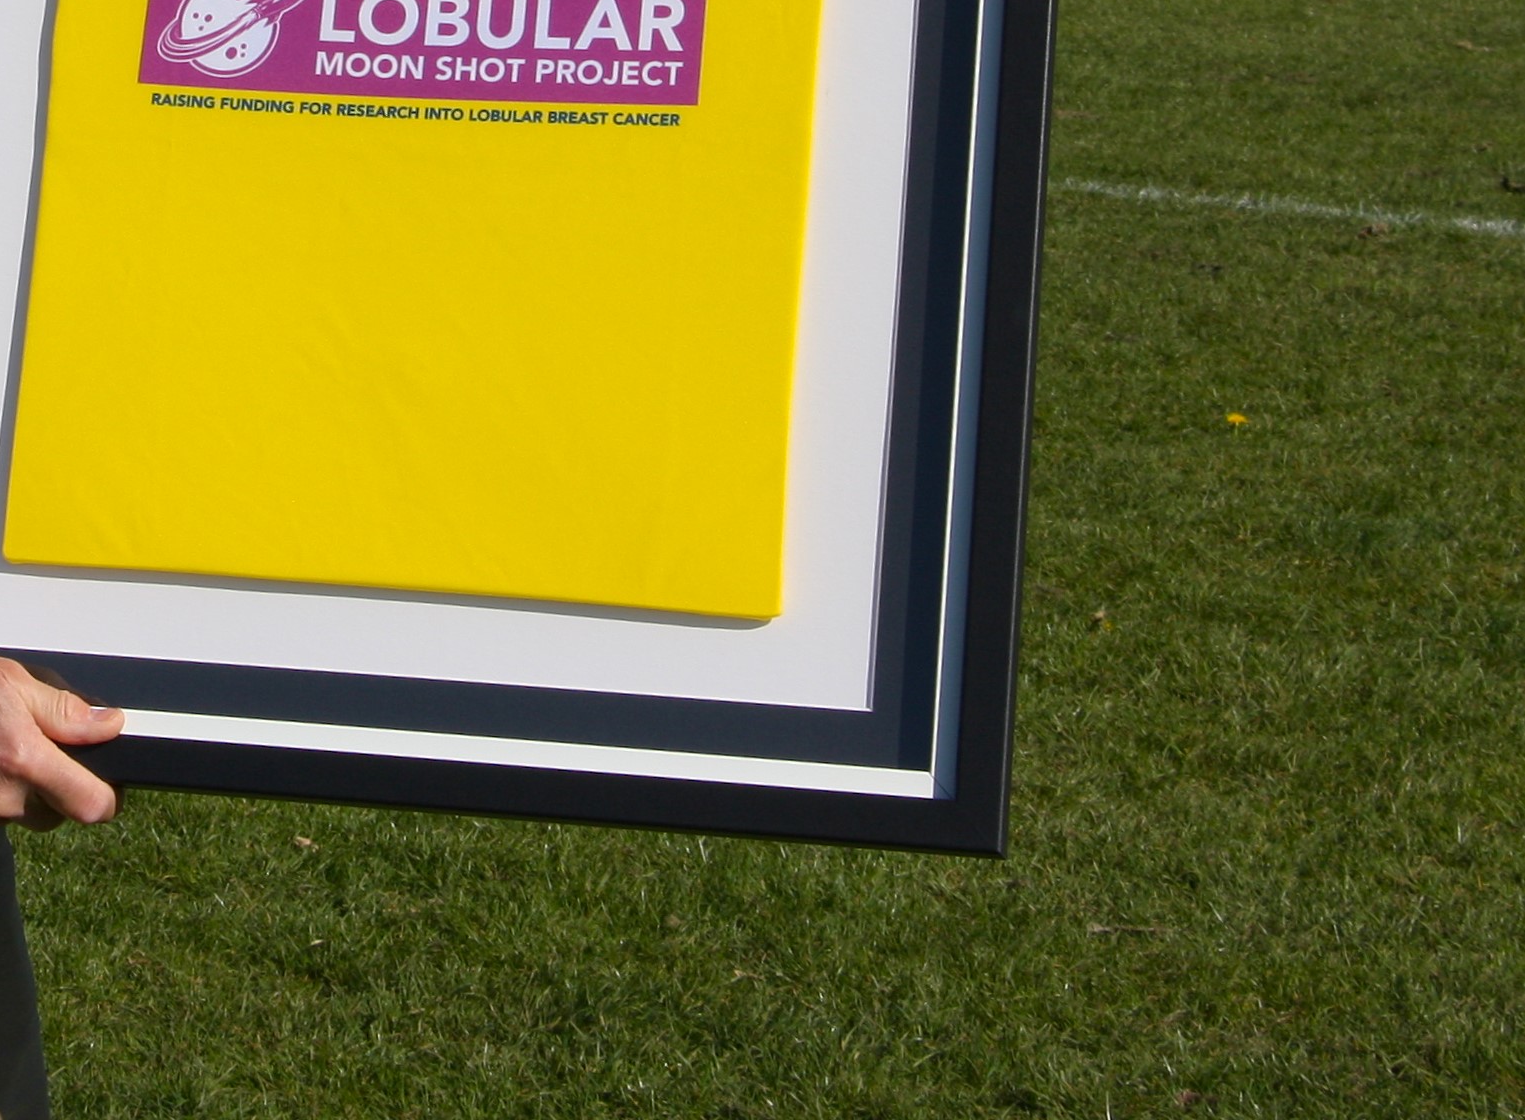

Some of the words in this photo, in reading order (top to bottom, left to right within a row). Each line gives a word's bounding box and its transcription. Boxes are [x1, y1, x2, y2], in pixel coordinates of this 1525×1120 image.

[315, 51, 425, 80] MOON
[435, 55, 526, 83] SHOT
[535, 59, 684, 86] PROJECT
[151, 93, 216, 109] RAISING
[220, 97, 295, 113] FUNDING
[299, 101, 332, 115] FOR
[336, 103, 419, 119] RESEARCH
[424, 107, 464, 121] INTO
[469, 109, 543, 124] LOBULAR
[548, 111, 608, 125] BREAST
[613, 113, 681, 126] CANCER
